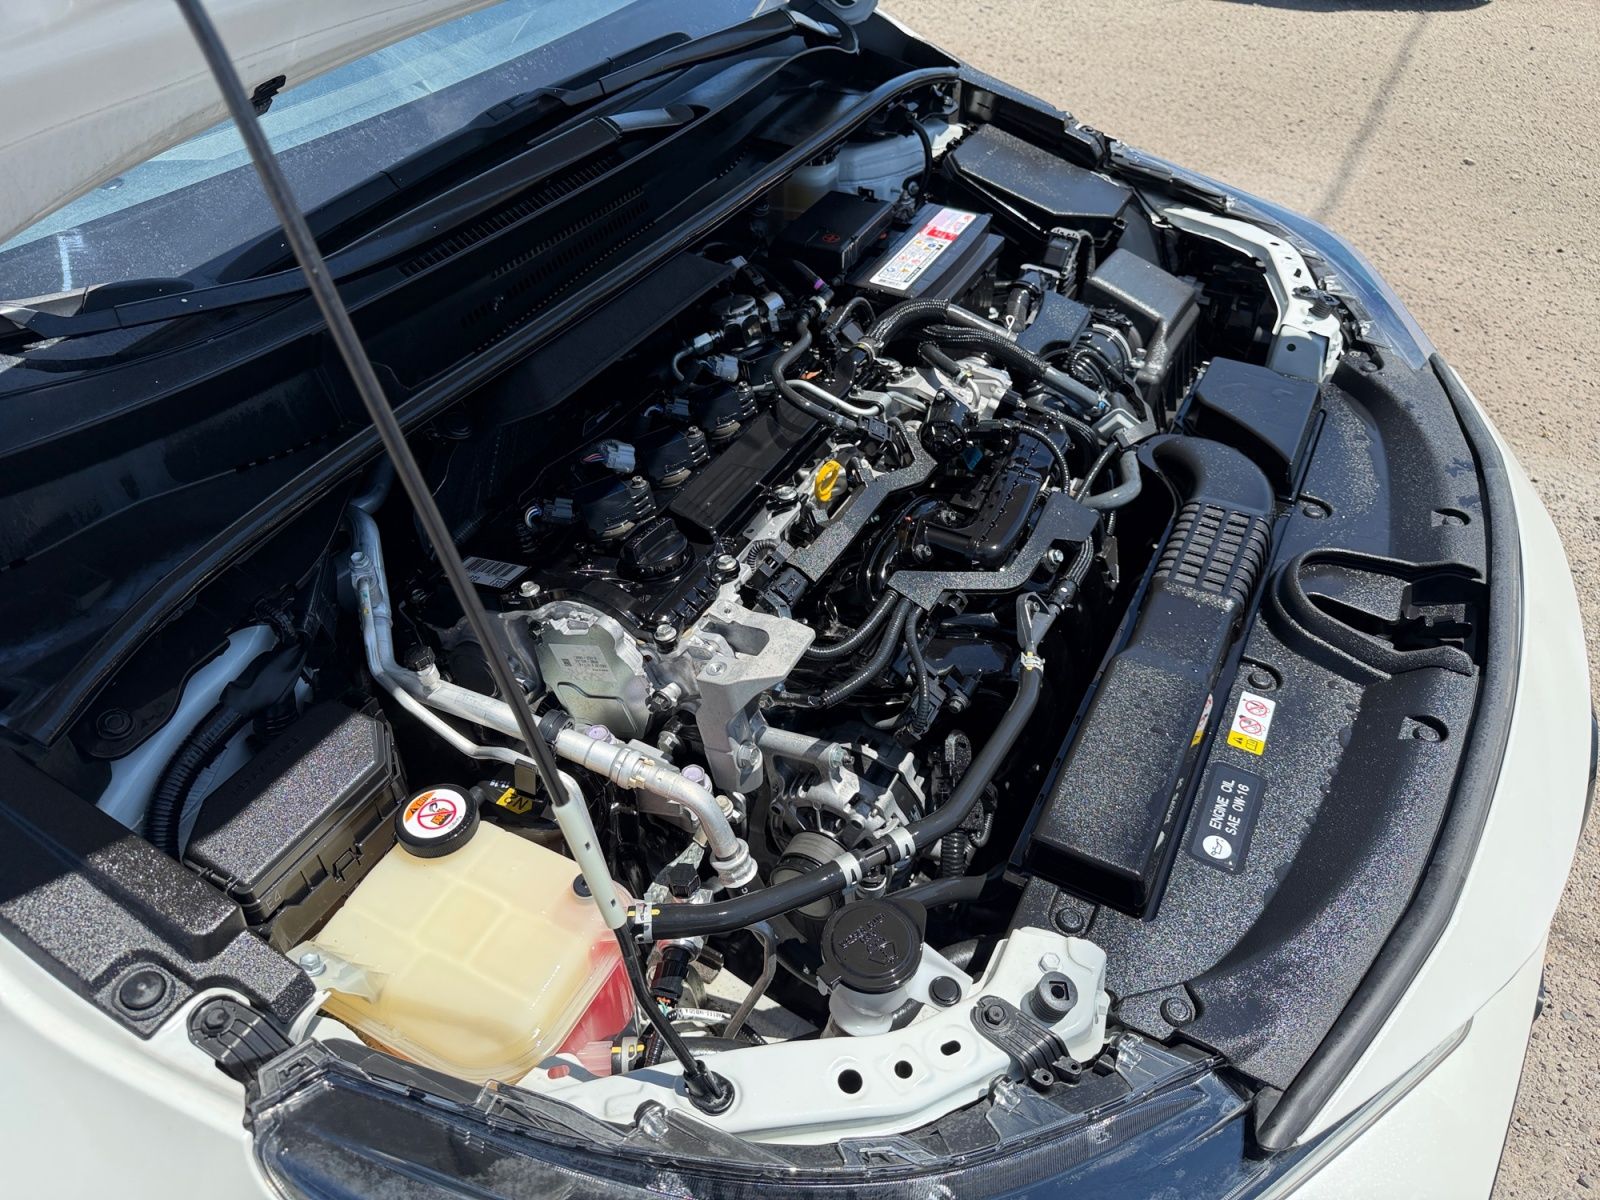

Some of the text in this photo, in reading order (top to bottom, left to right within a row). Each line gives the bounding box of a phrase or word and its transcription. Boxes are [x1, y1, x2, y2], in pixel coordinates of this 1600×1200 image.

[1209, 780, 1236, 830] ENGINE OIL
[1225, 783, 1250, 836] SAE 0W-16
[265, 890, 283, 911] E4
